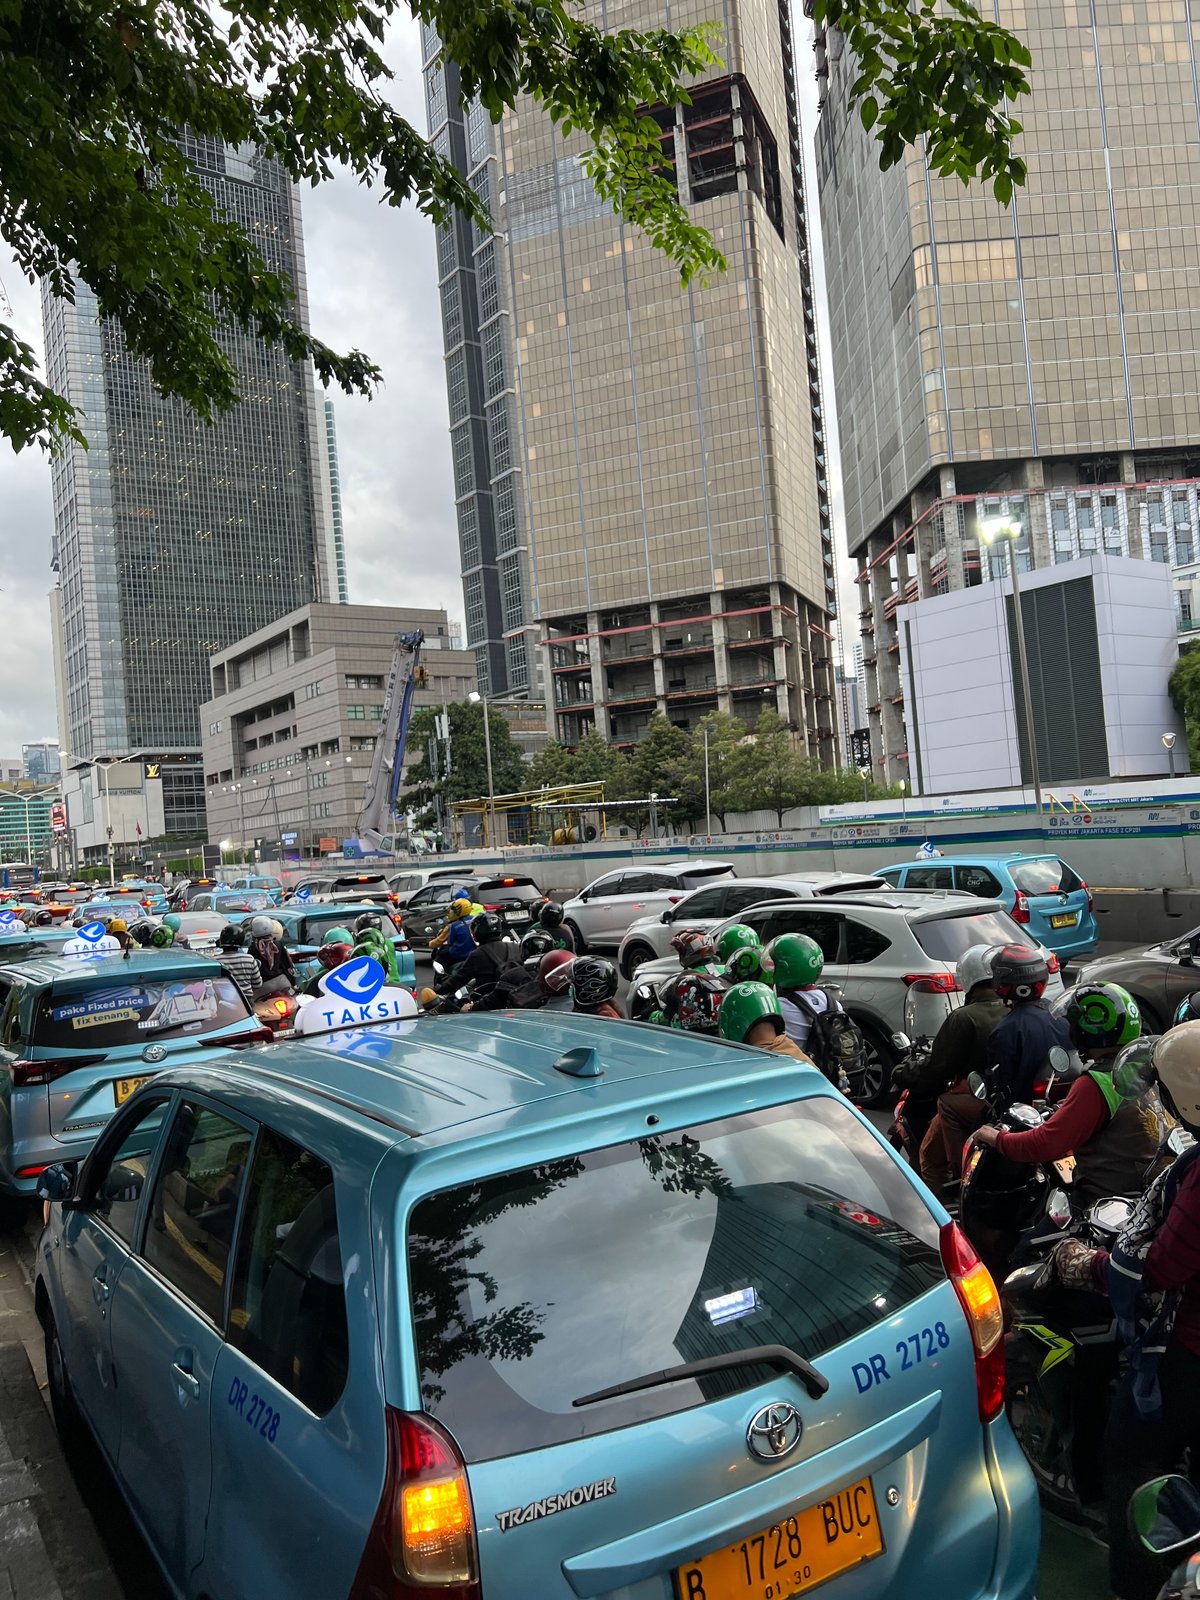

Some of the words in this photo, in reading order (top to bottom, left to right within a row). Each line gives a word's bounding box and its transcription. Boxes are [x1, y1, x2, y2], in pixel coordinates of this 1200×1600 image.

[74, 942, 112, 952] TAKSI
[59, 1005, 85, 1018] pake
[88, 1000, 116, 1012] Fixed
[118, 997, 144, 1008] Price
[76, 1016, 91, 1026] fix
[93, 1010, 130, 1023] tenang
[322, 1001, 400, 1027] TAKSI
[121, 1081, 130, 1094] B
[64, 1121, 107, 1131] TRANSMOVE
[851, 1353, 891, 1394] DR
[895, 1321, 950, 1371] 2728
[228, 1375, 248, 1416] DR
[246, 1393, 280, 1443] 2728
[495, 1476, 616, 1533] TRANSMOVER
[686, 1568, 707, 1600] B
[739, 1515, 802, 1586] 1728
[821, 1485, 871, 1544] BUC
[765, 1581, 781, 1600] 01
[793, 1564, 812, 1585] 30
